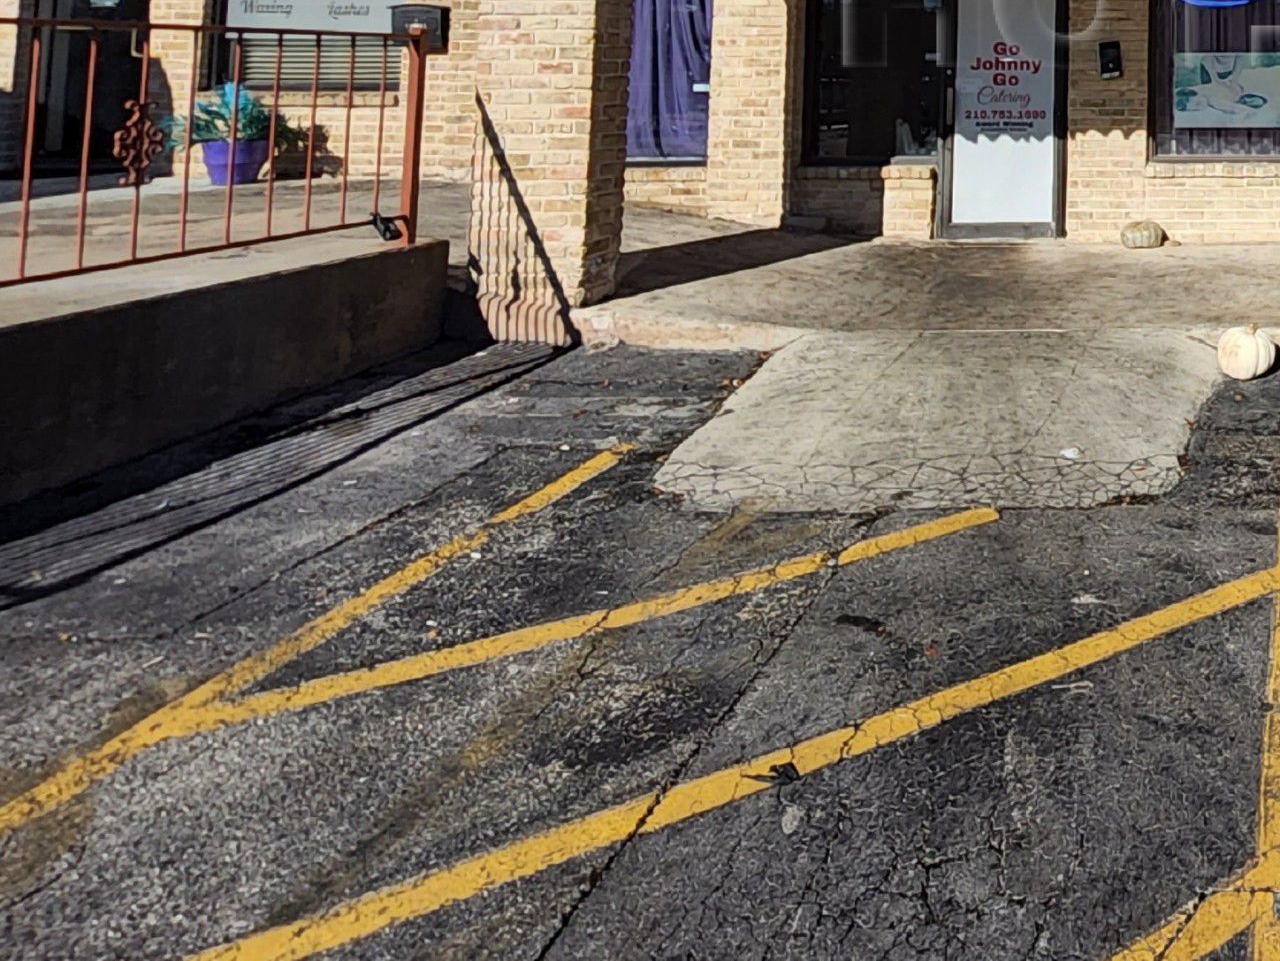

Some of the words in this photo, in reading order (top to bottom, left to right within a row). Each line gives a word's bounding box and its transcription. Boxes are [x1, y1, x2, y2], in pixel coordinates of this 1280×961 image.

[992, 41, 1021, 55] Go
[970, 57, 1042, 74] Johnny
[992, 73, 1020, 86] Go
[976, 85, 1032, 107] Catering
